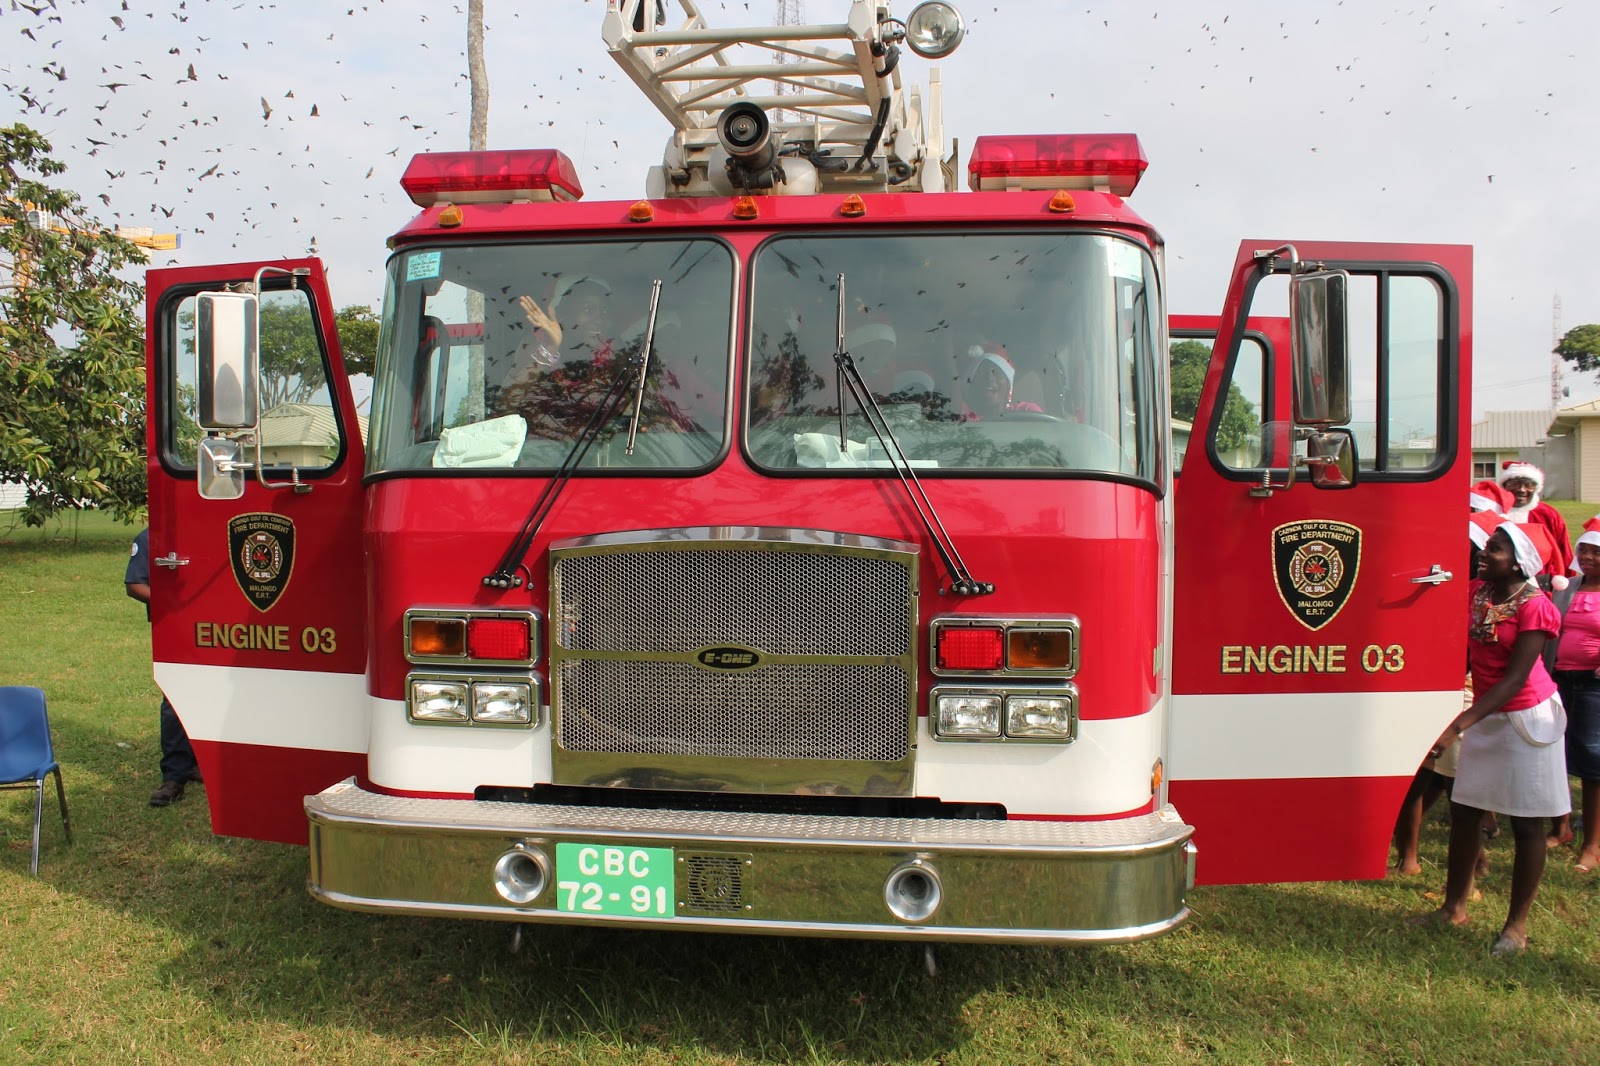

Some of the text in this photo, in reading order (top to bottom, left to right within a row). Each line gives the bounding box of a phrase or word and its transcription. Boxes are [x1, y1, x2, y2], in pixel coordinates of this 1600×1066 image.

[234, 522, 290, 534] FIRE DEPARTMENT
[1329, 524, 1356, 536] COMPANY
[1280, 531, 1354, 545] FIRE DEPARTMENT
[1305, 608, 1326, 616] E.R.T.
[196, 621, 337, 654] ENGINE 03
[704, 652, 753, 664] E-ONE
[1221, 644, 1405, 674] ENGINE 03
[578, 847, 650, 878] CBC
